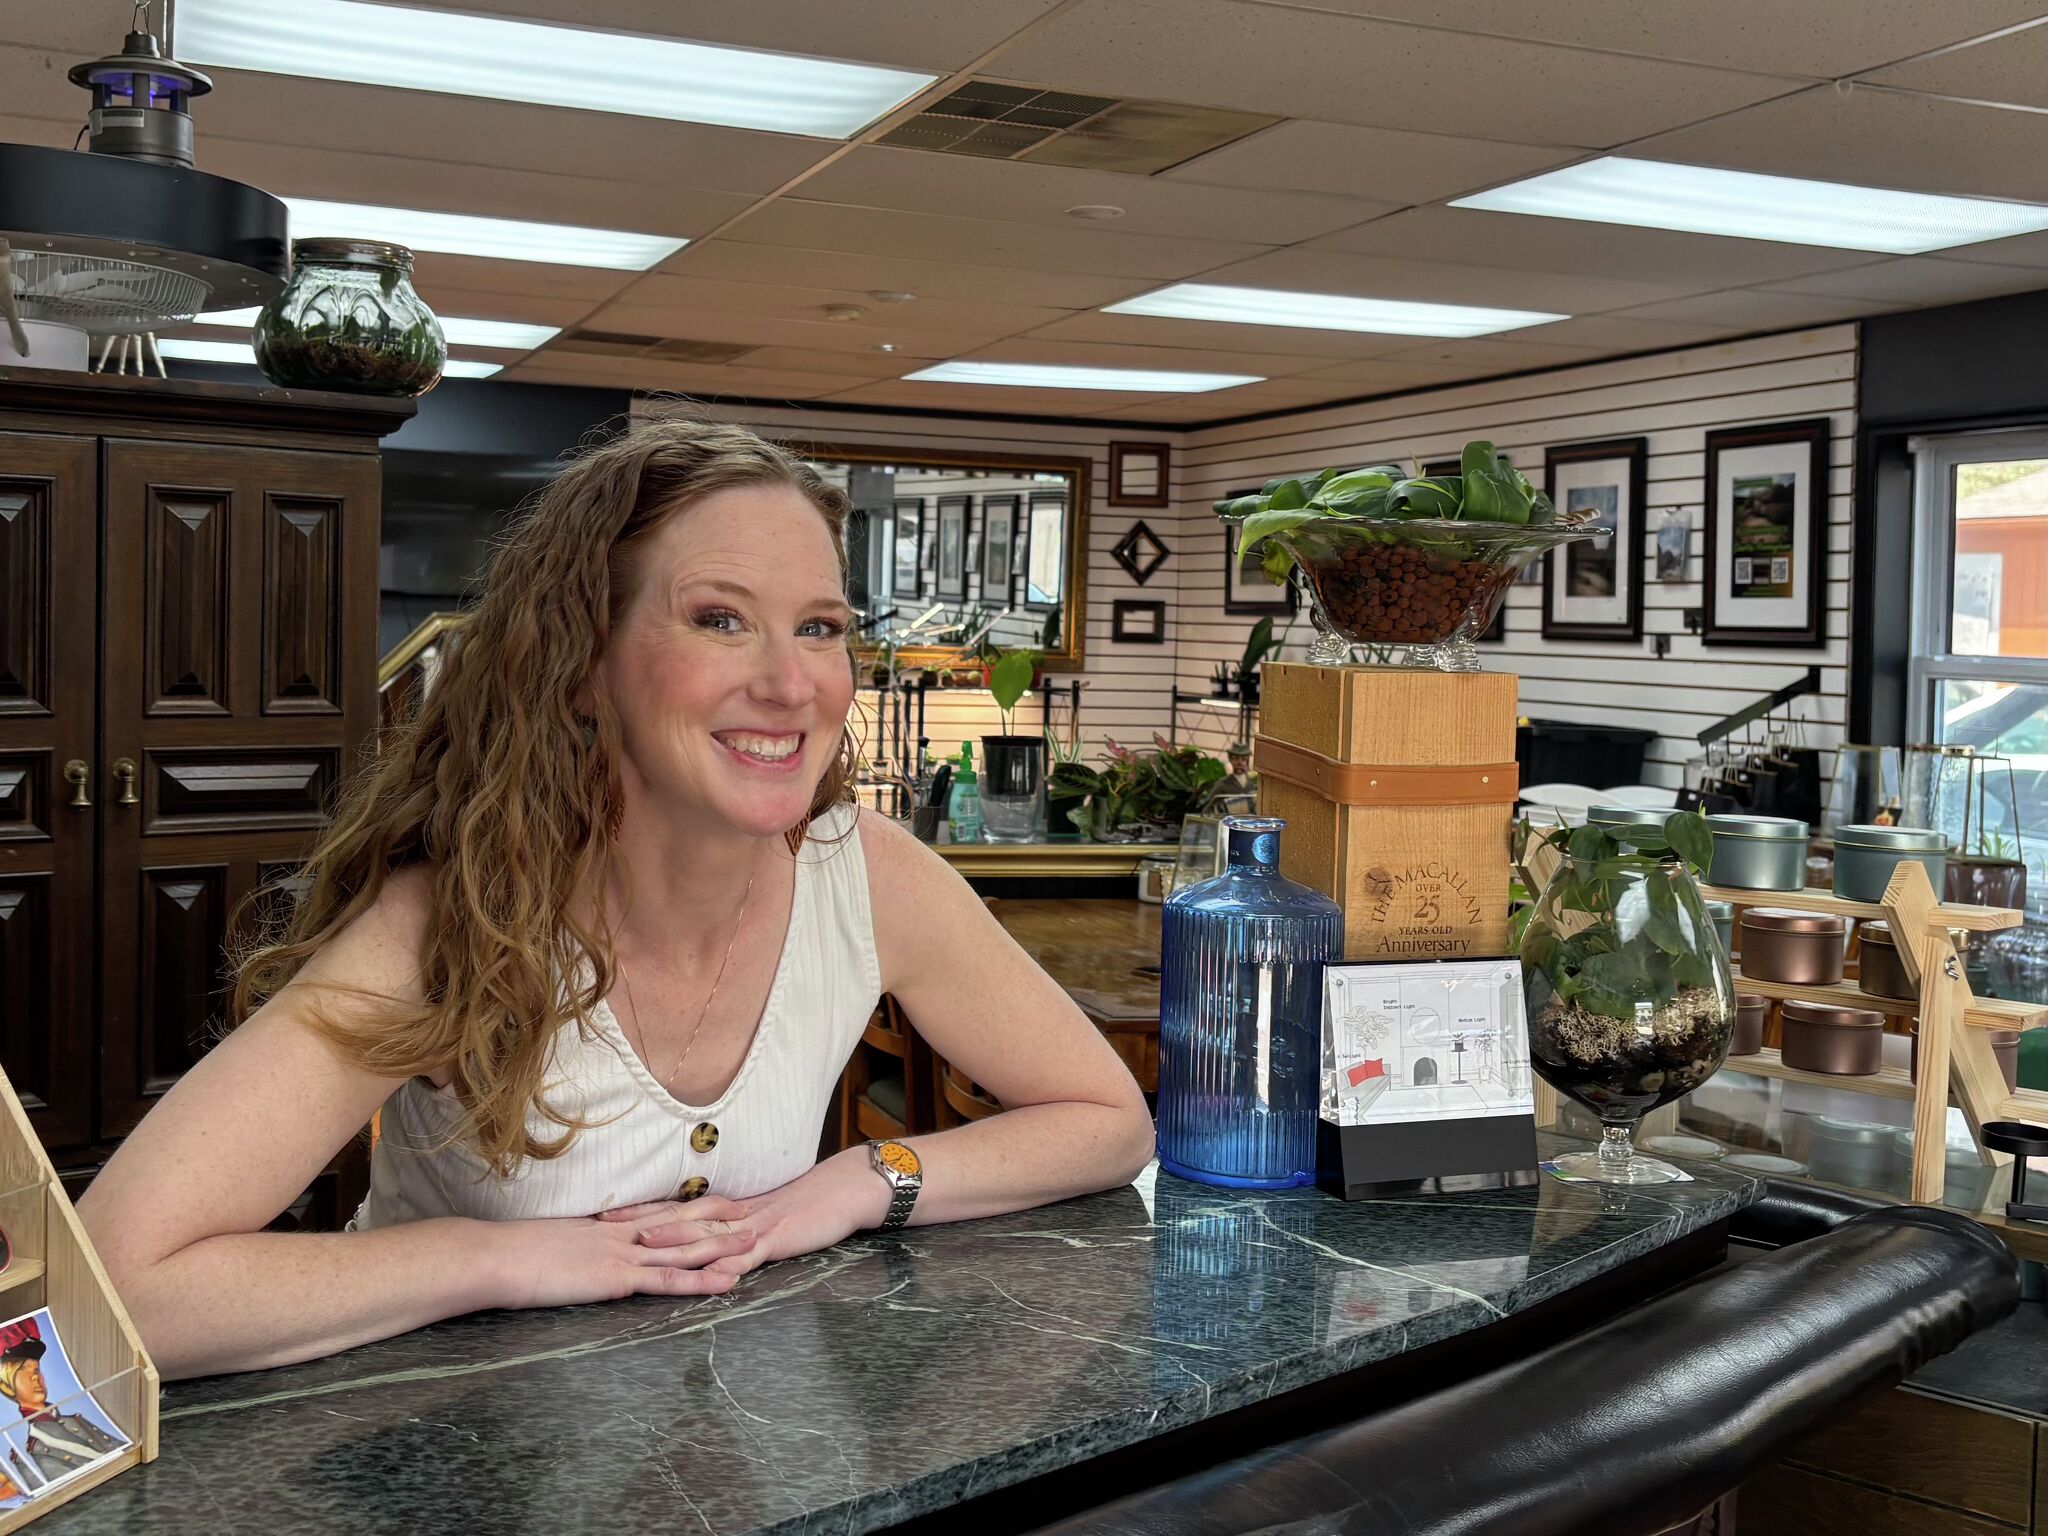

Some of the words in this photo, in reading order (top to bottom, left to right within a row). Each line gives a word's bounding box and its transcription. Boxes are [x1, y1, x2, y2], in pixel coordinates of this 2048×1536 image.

[1371, 885, 1396, 923] THE
[1394, 862, 1482, 925] MACALLAN
[1415, 883, 1441, 893] OVER
[1413, 894, 1440, 925] 25
[1398, 926, 1429, 935] YEARS
[1431, 926, 1453, 935] OLD
[1376, 935, 1471, 955] Anniversary
